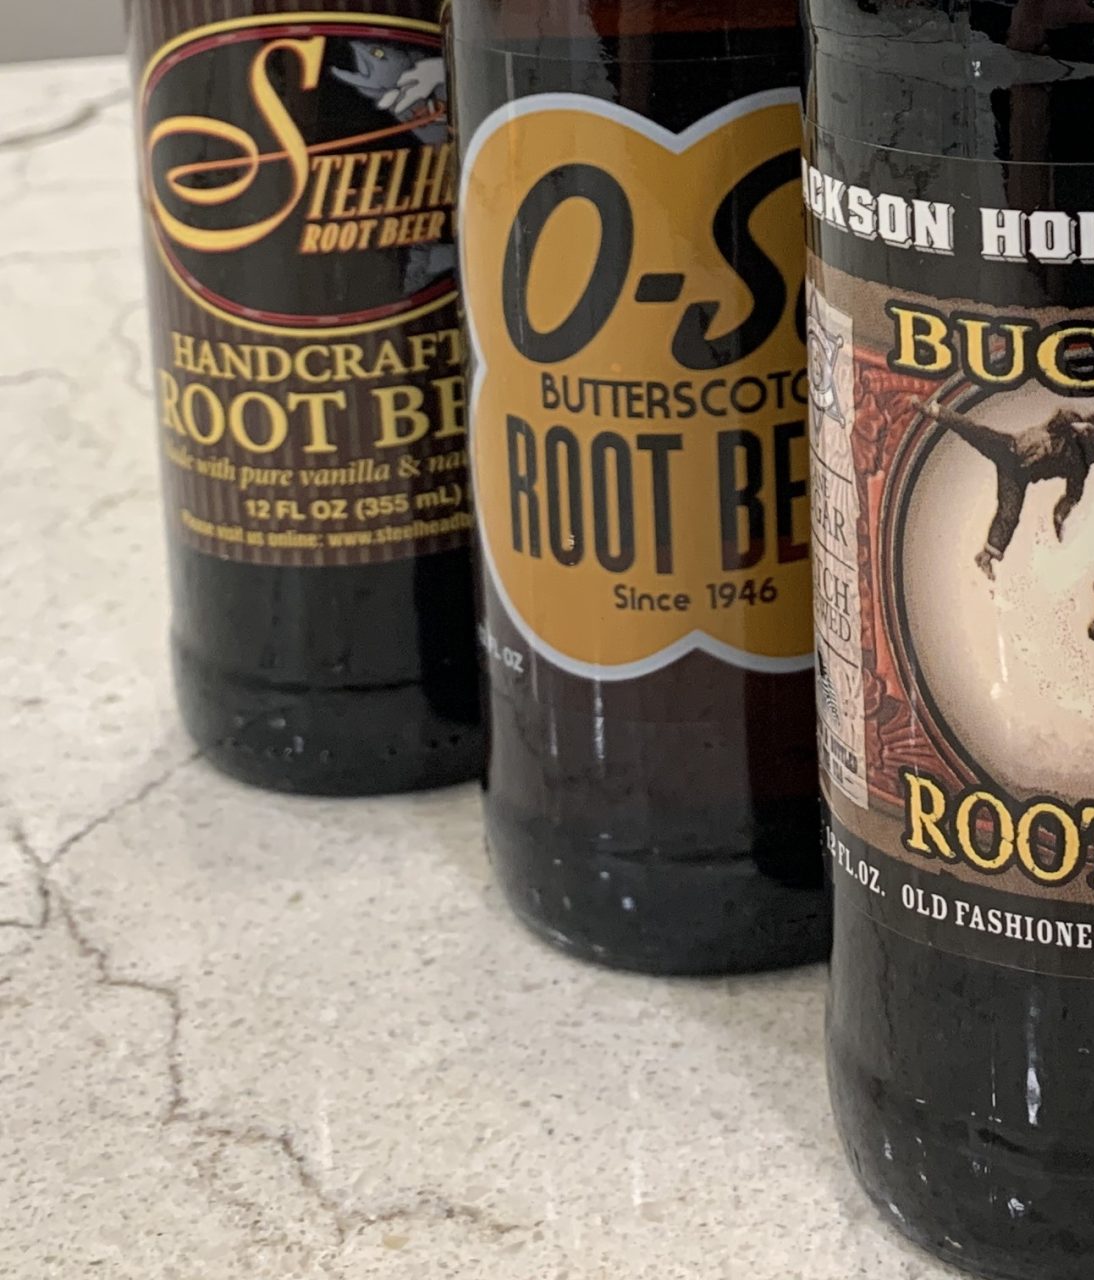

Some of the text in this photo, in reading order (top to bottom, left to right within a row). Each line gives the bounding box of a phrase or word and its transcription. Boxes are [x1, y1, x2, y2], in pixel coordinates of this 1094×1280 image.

[150, 35, 456, 252] STEELH
[301, 211, 446, 254] ROOT BEER
[502, 147, 806, 371] O-S
[159, 369, 346, 454] ROOT
[239, 465, 294, 491] pure
[301, 459, 391, 487] vanilla
[398, 453, 421, 478] &
[505, 413, 683, 574] ROOT
[246, 484, 462, 521] 12 FL OZ (355 mL)
[612, 577, 778, 612] Since 1946
[902, 883, 948, 921] OLD
